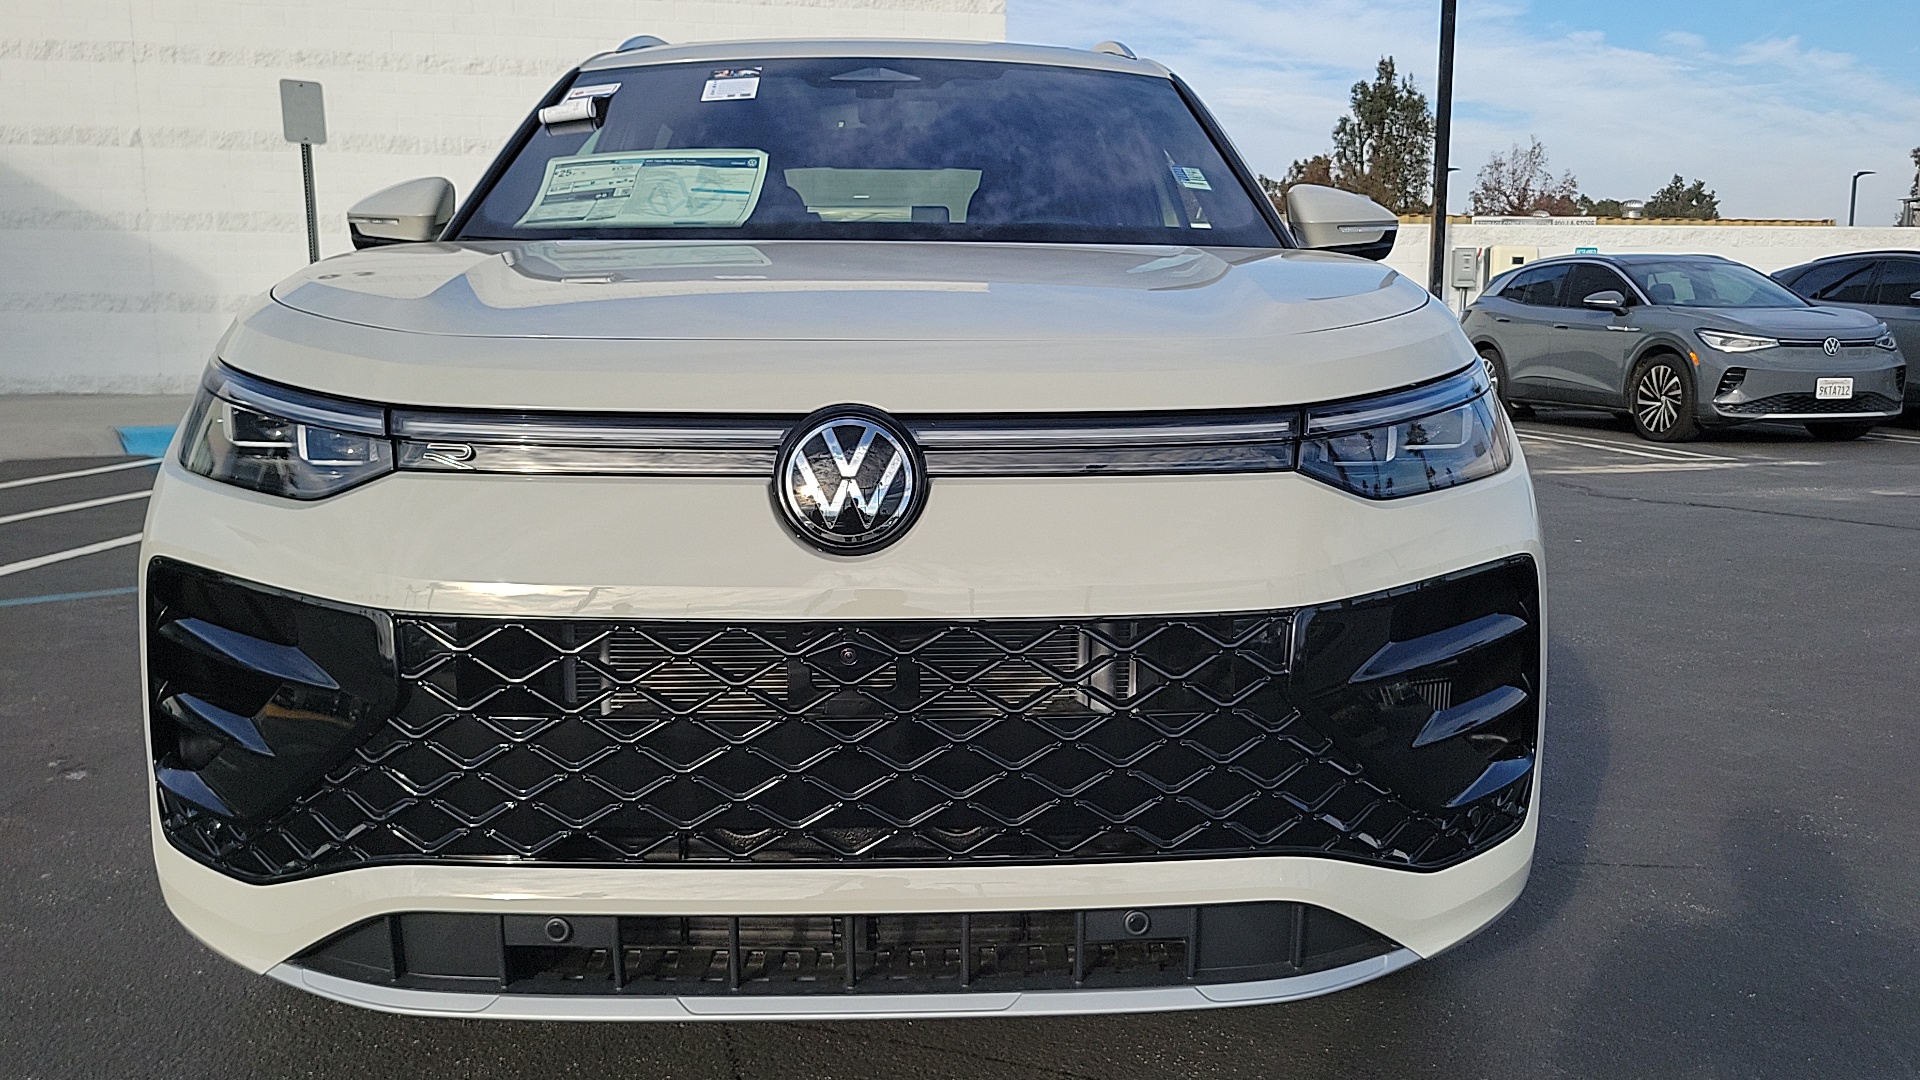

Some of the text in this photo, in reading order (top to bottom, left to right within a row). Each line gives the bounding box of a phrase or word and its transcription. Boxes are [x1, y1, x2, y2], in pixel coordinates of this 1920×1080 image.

[1825, 338, 1840, 354] VW
[1818, 385, 1851, 396] 9KTA712
[422, 442, 477, 470] R
[793, 423, 905, 532] VW
